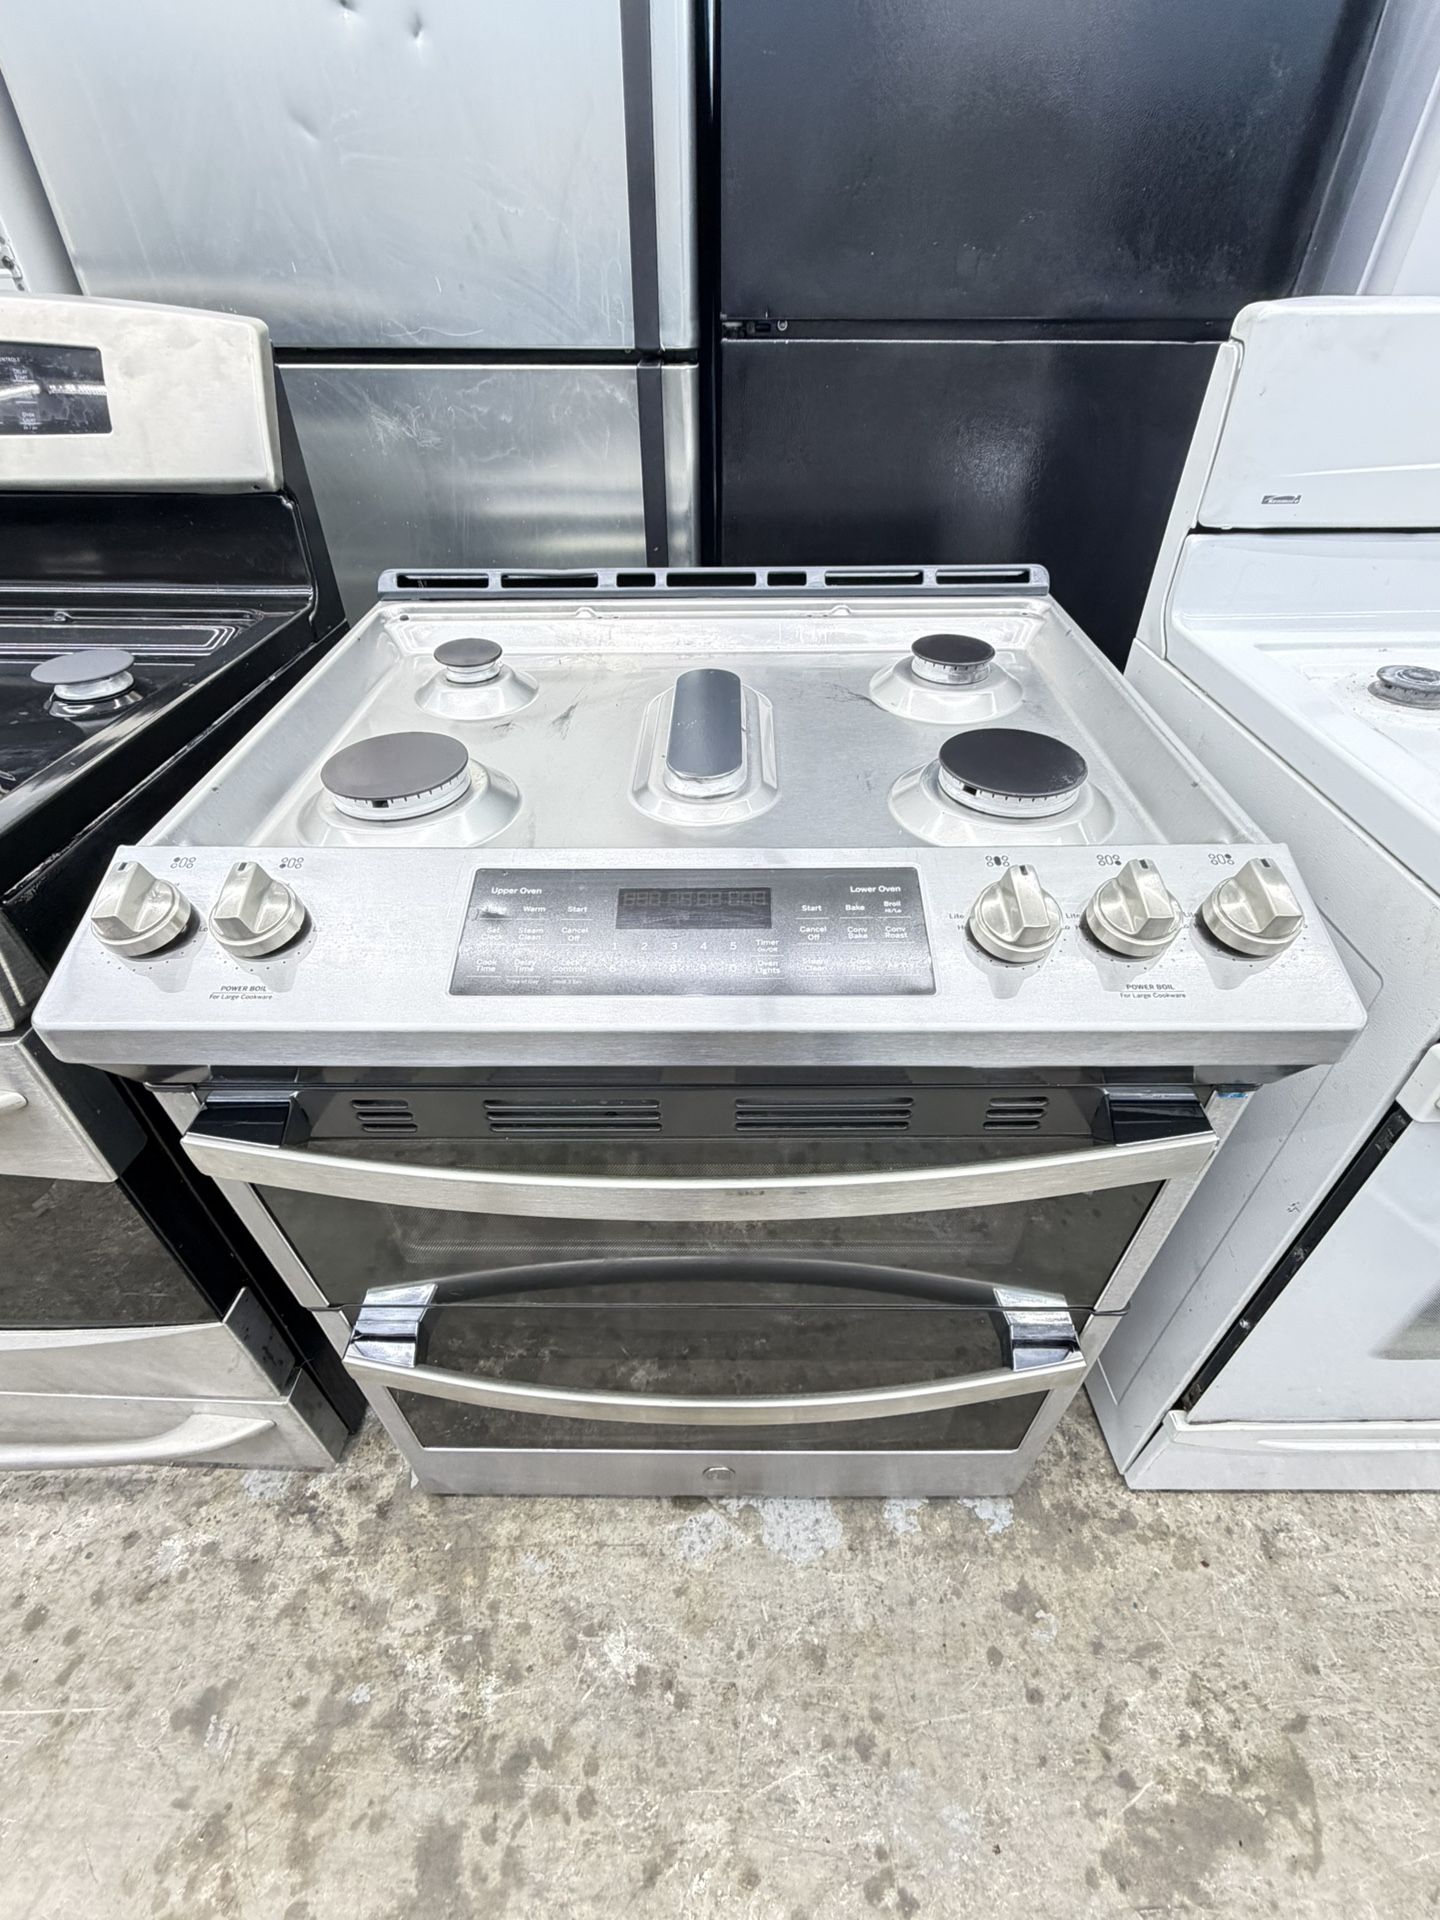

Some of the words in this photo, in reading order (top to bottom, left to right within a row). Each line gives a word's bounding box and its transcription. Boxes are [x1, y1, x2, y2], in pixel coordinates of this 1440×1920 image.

[491, 886, 519, 895] Upper
[520, 887, 543, 895] Oven
[850, 885, 877, 893] Lower
[878, 885, 901, 893] Oven
[523, 905, 546, 913] Warm
[567, 905, 588, 913] Start
[801, 904, 822, 912] Start
[807, 933, 821, 941] Off
[640, 942, 648, 951] 2
[671, 942, 678, 951] 3
[700, 942, 707, 951] 4
[730, 942, 738, 951] 5
